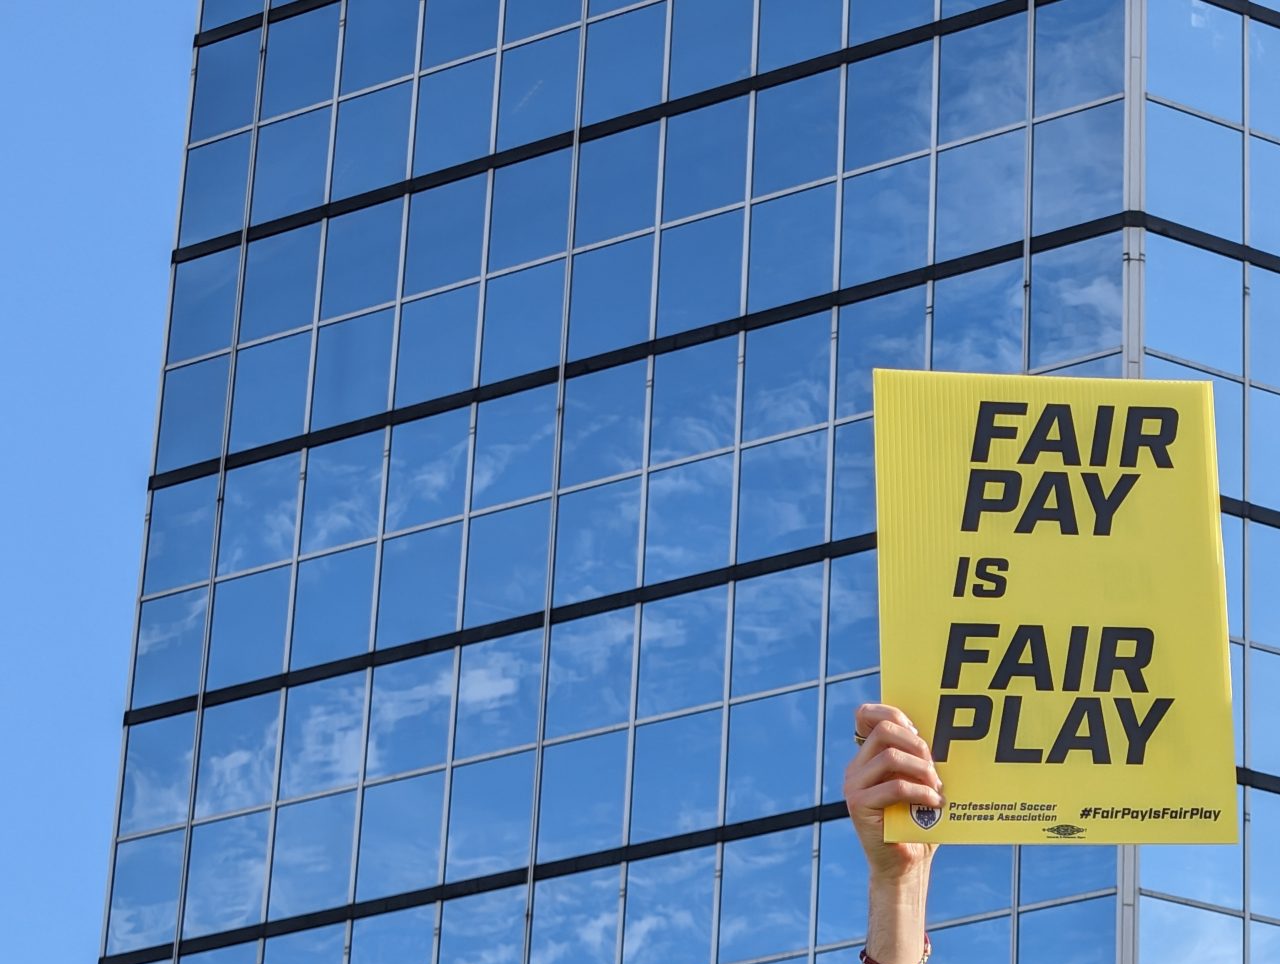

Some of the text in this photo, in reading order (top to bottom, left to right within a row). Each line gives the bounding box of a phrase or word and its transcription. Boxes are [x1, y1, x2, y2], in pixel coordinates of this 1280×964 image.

[970, 401, 1179, 469] FAIR
[960, 469, 1141, 536] PAY
[952, 557, 1009, 598] IS
[940, 623, 1154, 693] FAIR
[931, 694, 1175, 765] PLAY
[949, 802, 1057, 811] Professional Soccer
[950, 813, 1057, 821] Referees Association
[1080, 807, 1221, 821] #FairPayIsFairPlay
